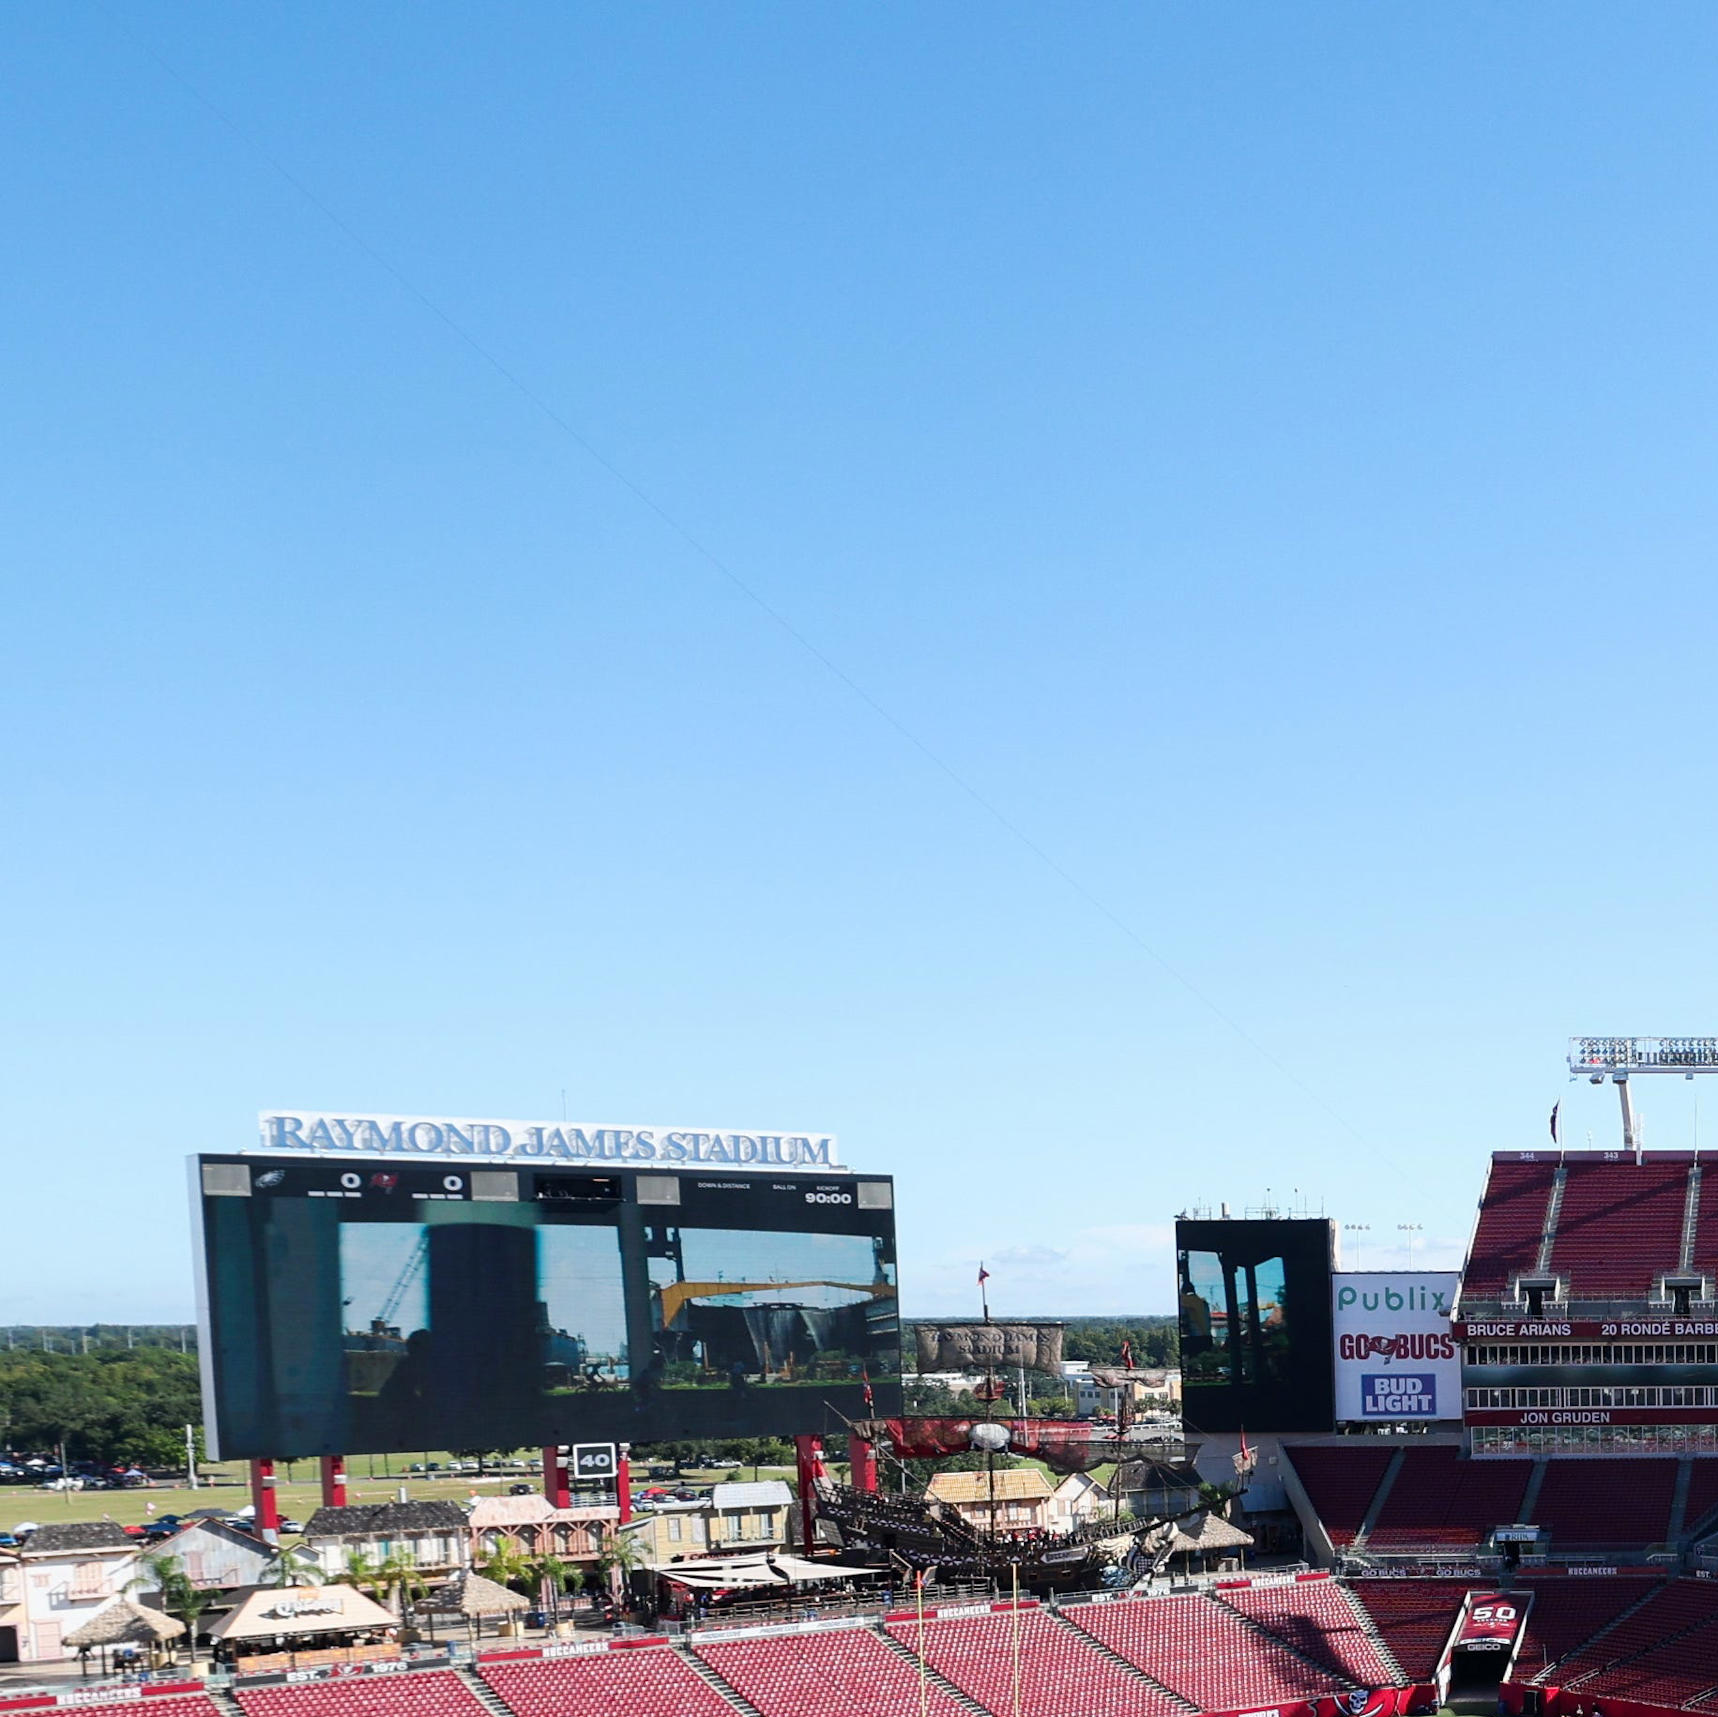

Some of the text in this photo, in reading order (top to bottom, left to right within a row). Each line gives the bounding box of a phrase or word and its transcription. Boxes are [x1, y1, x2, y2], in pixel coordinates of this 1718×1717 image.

[263, 1115, 832, 1164] RAYMOND JAMES STADIUM
[340, 1173, 362, 1189] 0
[443, 1176, 463, 1191] 0
[805, 1193, 852, 1204] 90:00
[1338, 1286, 1445, 1311] Publix
[1467, 1323, 1571, 1337] BRUCE ARIANS
[1601, 1323, 1617, 1336] 20
[1621, 1321, 1671, 1336] RONDÉ
[1340, 1333, 1455, 1360] GO BUCS
[1374, 1378, 1423, 1395] BUD
[1366, 1395, 1432, 1412] LIGHT
[1520, 1412, 1611, 1424] JON GRUDEN
[579, 1453, 610, 1468] 40
[1361, 1569, 1407, 1577] GO BUCS
[1436, 1569, 1481, 1577] GO BUCS
[1567, 1566, 1618, 1576] BUCCANEERS
[1252, 1574, 1297, 1588] BUCCANEERS
[937, 1605, 991, 1619] BUCCANEERS
[1472, 1606, 1516, 1620] 50
[543, 1641, 609, 1658] BUCCANEERS
[1467, 1643, 1501, 1651] GEICO
[287, 1661, 408, 1683] EST. 1976
[56, 1687, 142, 1707] BUCCANEERS
